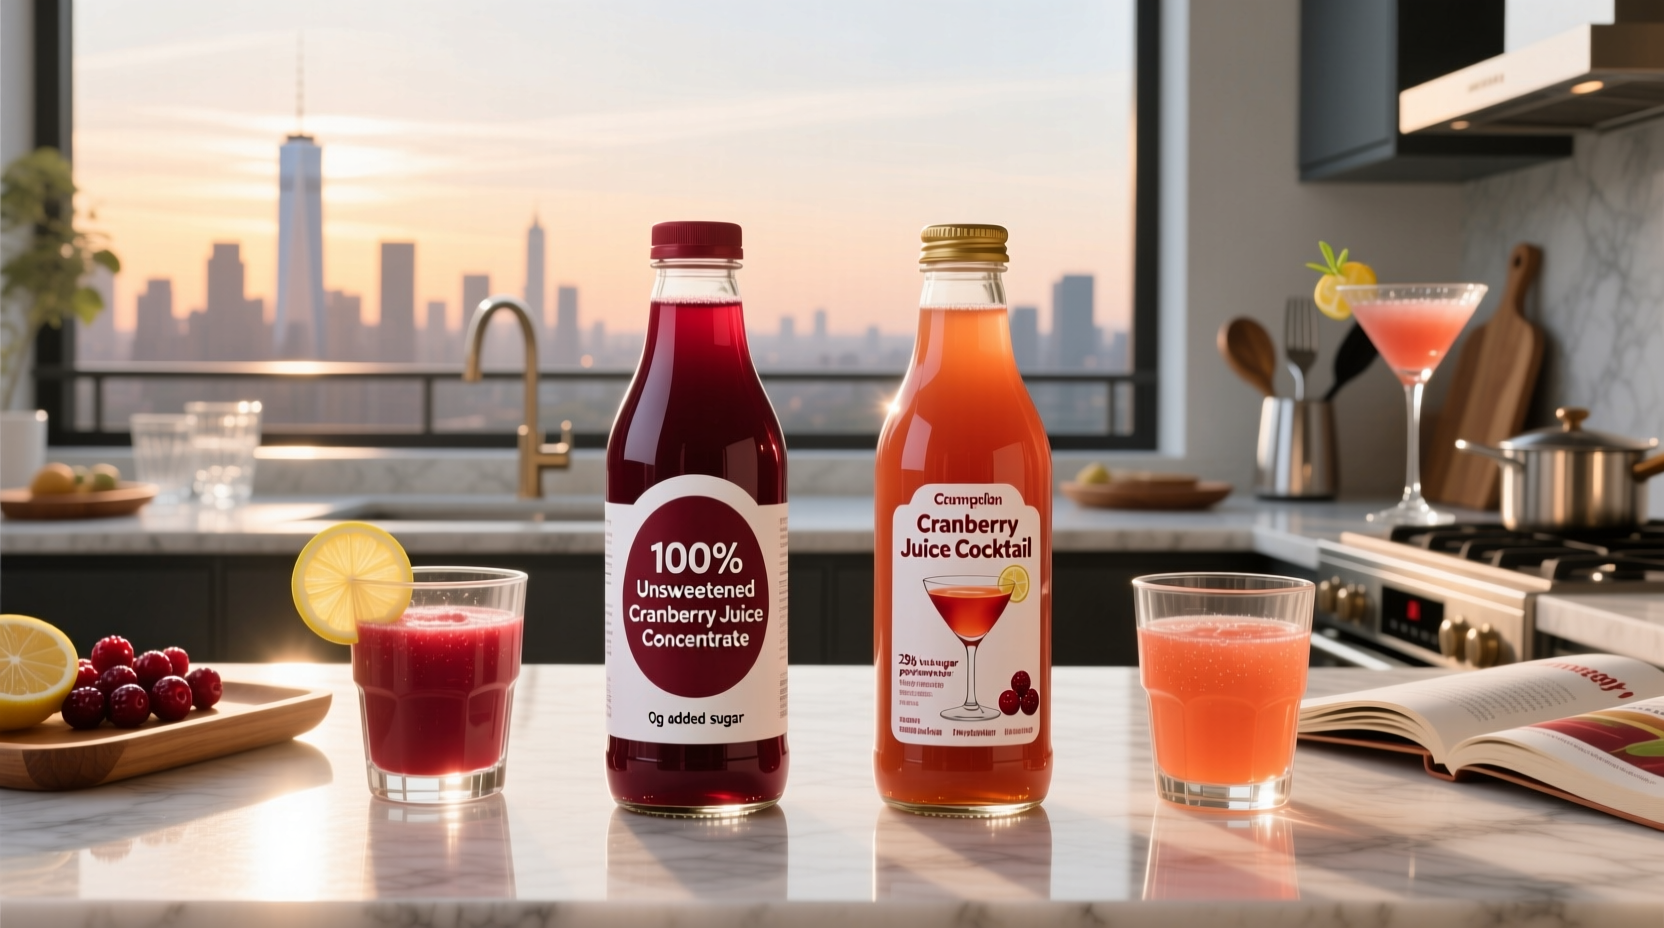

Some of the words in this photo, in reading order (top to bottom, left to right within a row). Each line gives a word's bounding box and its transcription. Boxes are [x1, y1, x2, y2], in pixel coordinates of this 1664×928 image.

[917, 513, 1019, 537] Cranberry
[651, 542, 743, 574] 100%
[901, 538, 951, 558] Juice
[955, 536, 1032, 558] Cocktail
[637, 579, 755, 598] Unsweetened
[629, 604, 716, 627] Cranberry
[719, 604, 764, 623] Juice
[642, 629, 749, 647] Concentrate
[648, 711, 664, 727] 0g
[668, 712, 706, 725] added
[710, 713, 745, 727] sugar
